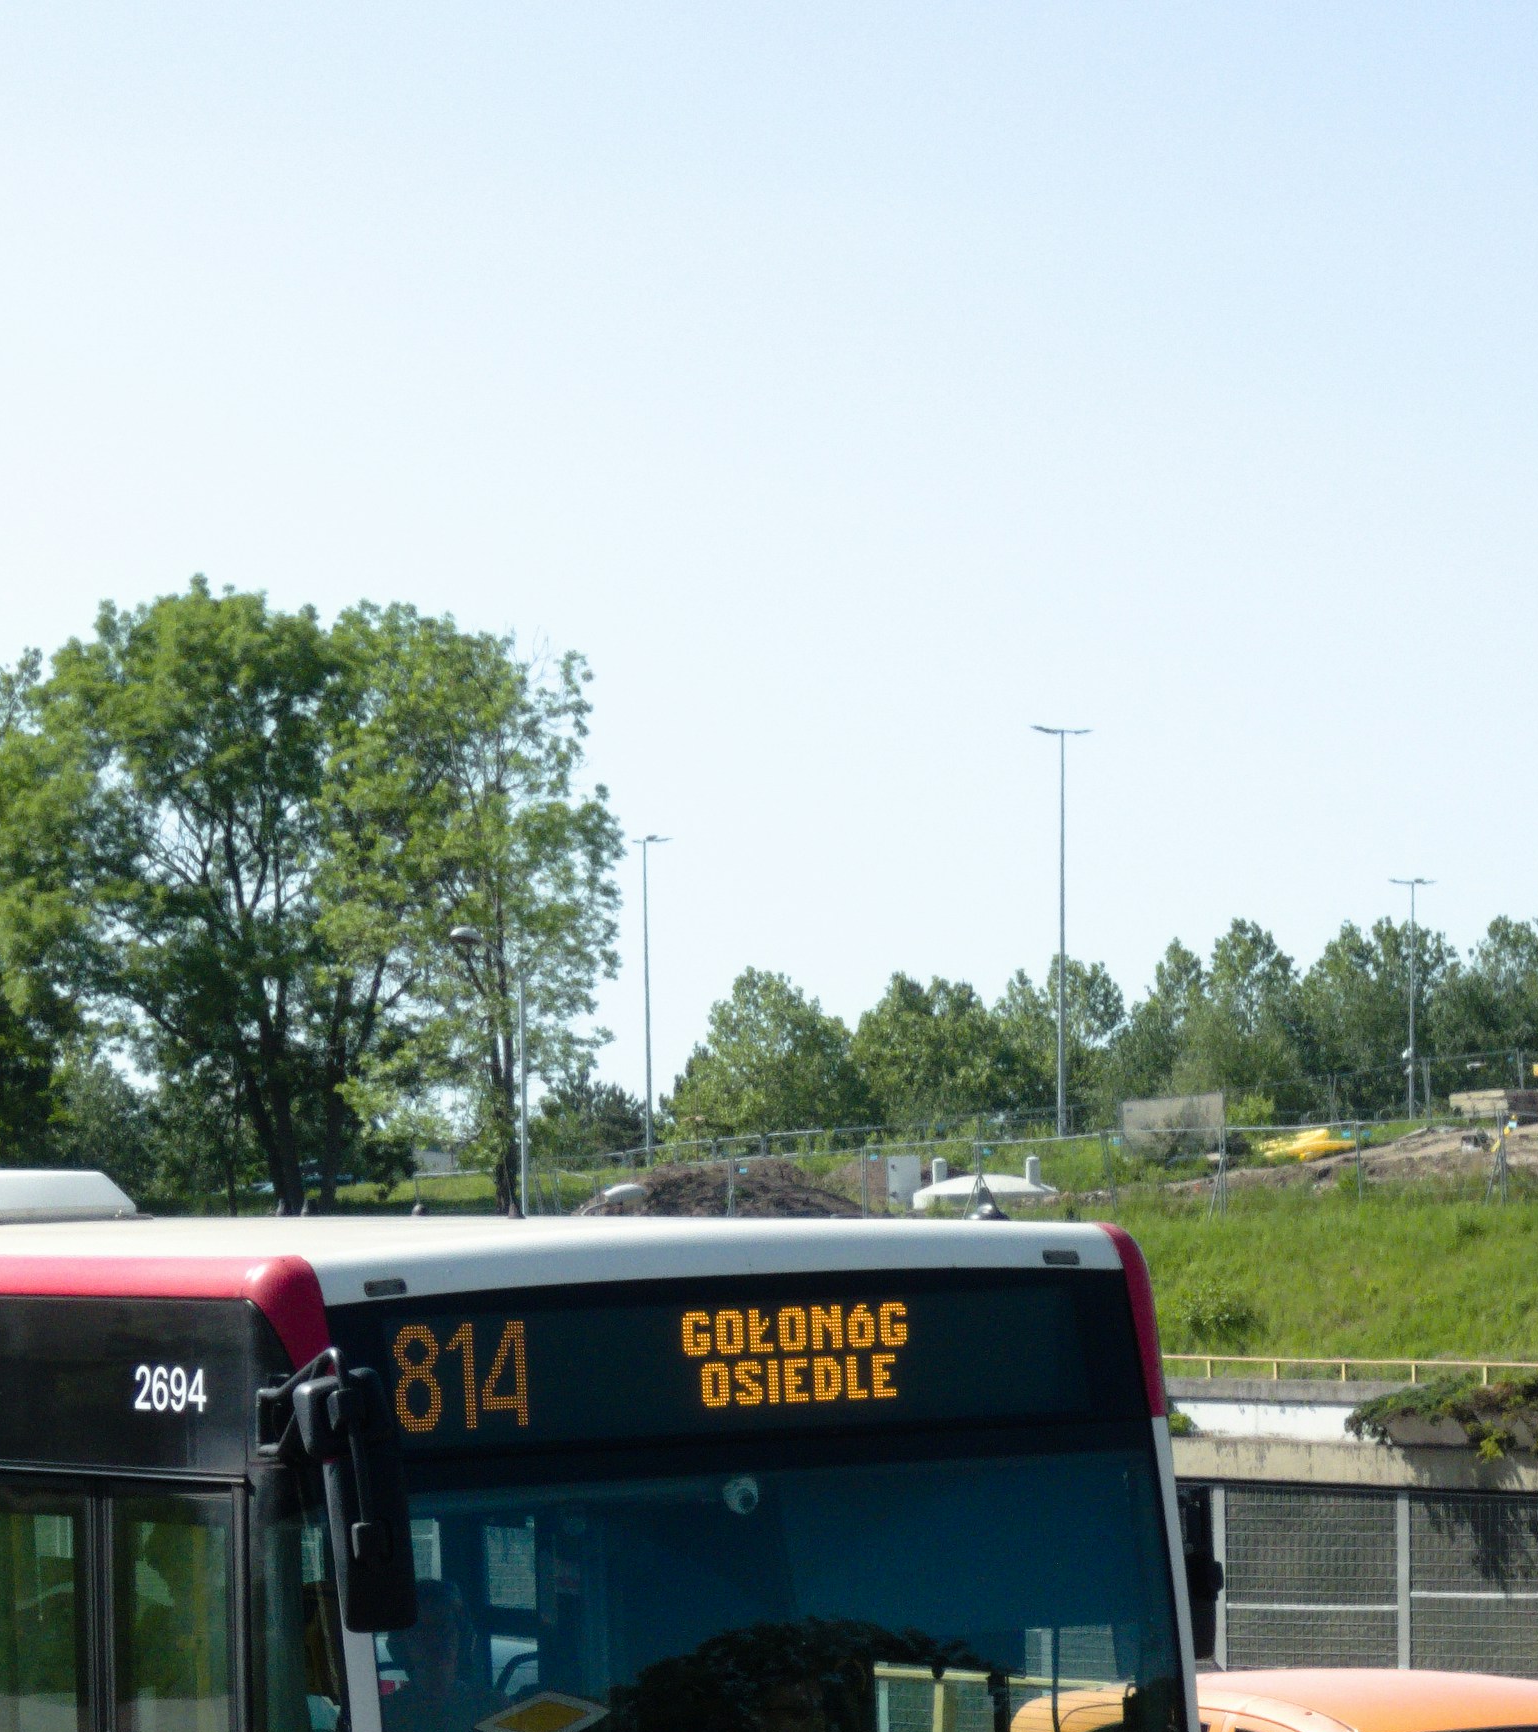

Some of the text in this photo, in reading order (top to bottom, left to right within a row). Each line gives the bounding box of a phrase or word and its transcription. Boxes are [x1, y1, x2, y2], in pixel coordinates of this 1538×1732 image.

[133, 1364, 208, 1413] 2694
[392, 1320, 530, 1432] 814
[700, 1352, 899, 1408] OSIEDLE
